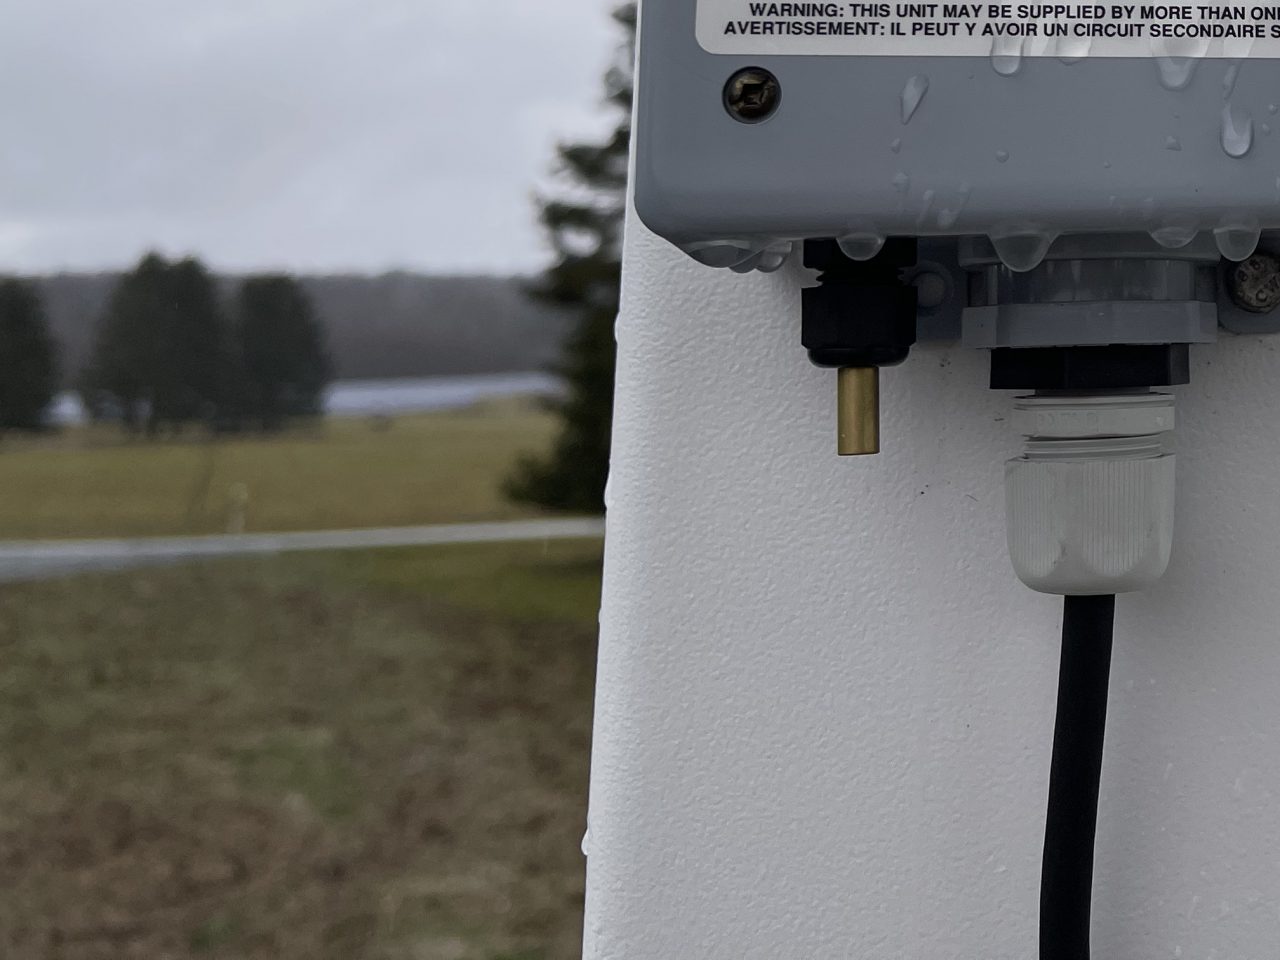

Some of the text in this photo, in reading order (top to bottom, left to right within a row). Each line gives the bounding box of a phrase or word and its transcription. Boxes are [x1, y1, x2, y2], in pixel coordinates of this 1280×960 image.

[749, 3, 843, 17] WARNING:
[849, 4, 890, 17] THIS
[897, 4, 938, 17] UNIT
[943, 5, 982, 18] MAY
[988, 5, 1011, 18] BE
[1018, 5, 1105, 19] SUPPLIED
[1112, 6, 1135, 19] BY
[1141, 6, 1192, 19] MORE
[1197, 6, 1245, 20] THAN
[724, 21, 884, 35] AVERTISSEMENT:
[891, 22, 906, 35] IL
[912, 23, 960, 36] PEUT
[965, 23, 976, 36] Y
[982, 23, 1037, 36] AVOIR
[1044, 23, 1068, 36] UN
[1074, 23, 1145, 37] CIRCUIT
[1150, 24, 1265, 38] SECONDAIRE
